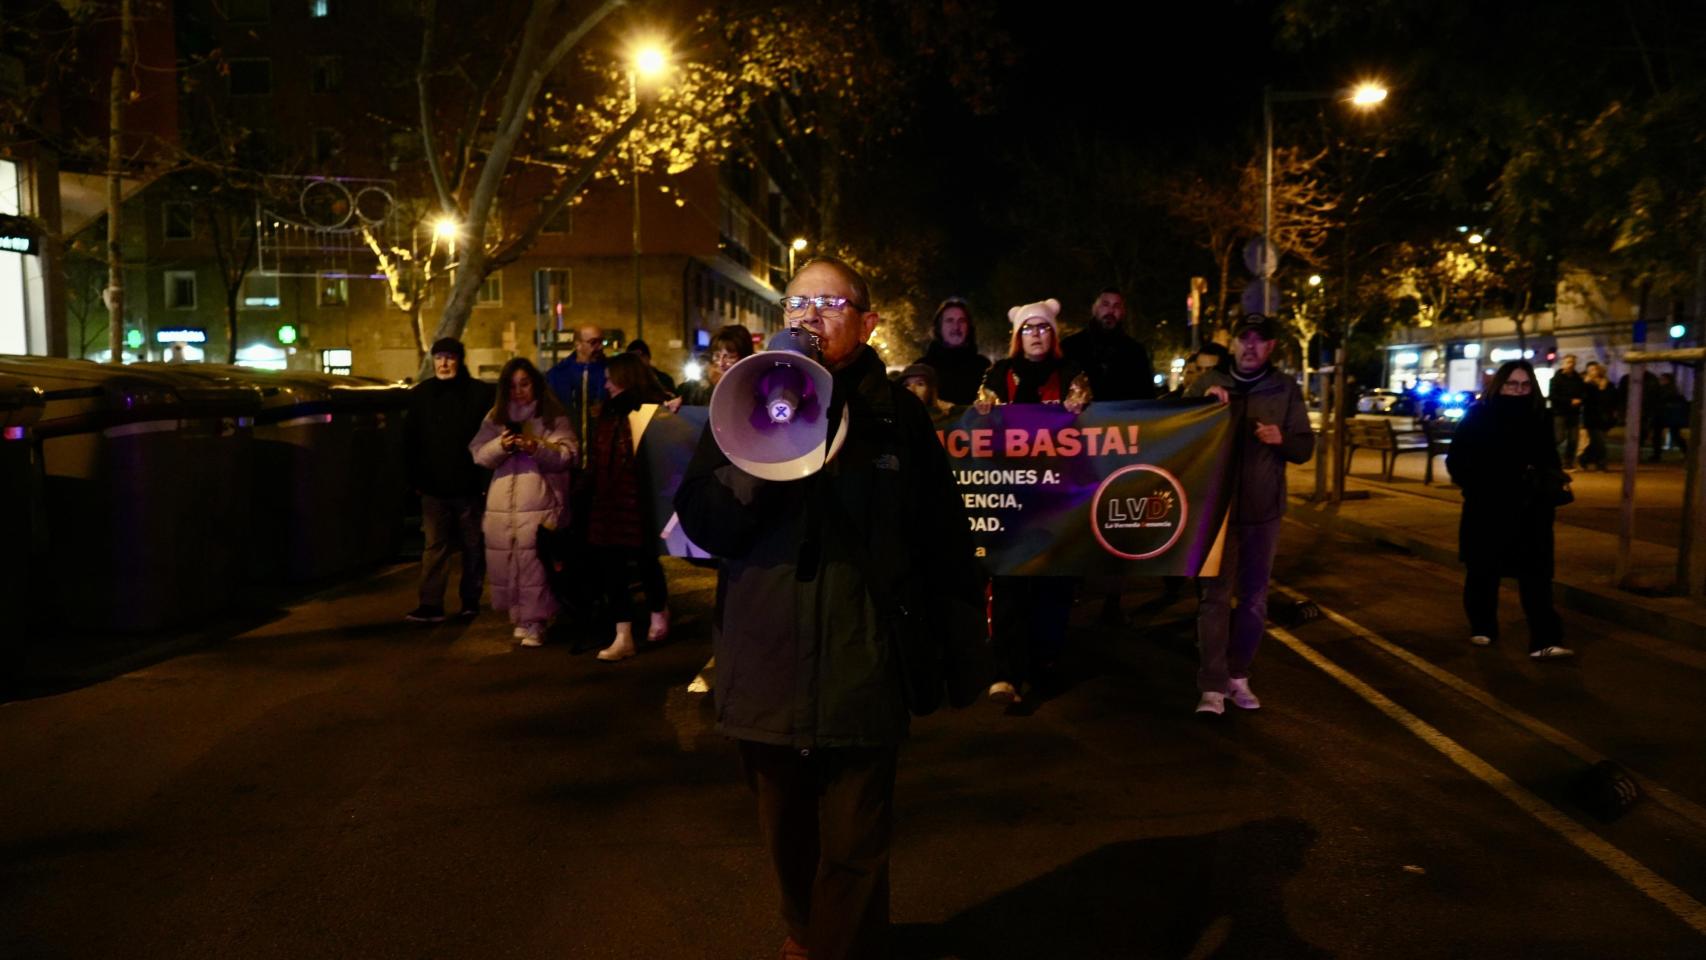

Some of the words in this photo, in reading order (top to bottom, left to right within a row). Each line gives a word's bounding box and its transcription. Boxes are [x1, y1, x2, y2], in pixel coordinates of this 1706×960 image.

[1005, 425, 1139, 457] BASTA!
[1042, 469, 1060, 485] A:
[962, 493, 1023, 511] ENCIA,
